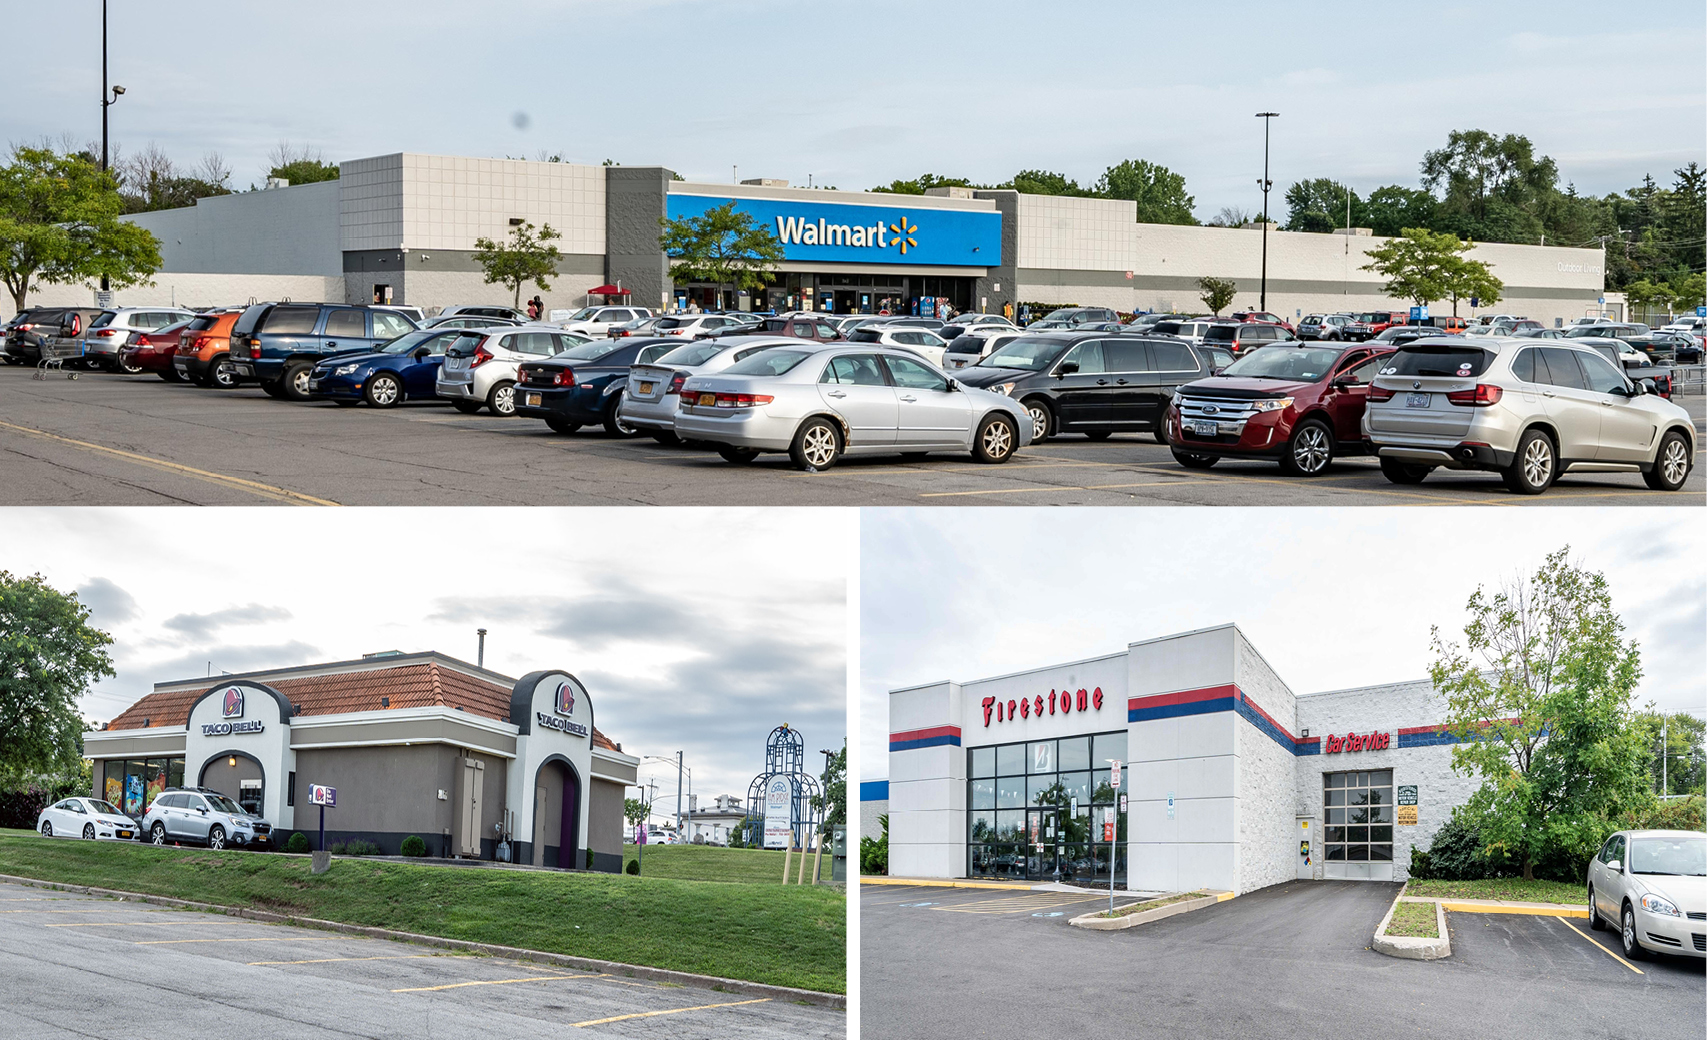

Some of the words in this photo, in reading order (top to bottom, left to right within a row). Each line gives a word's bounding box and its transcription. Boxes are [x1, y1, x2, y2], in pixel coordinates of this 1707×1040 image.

[776, 215, 887, 248] Walmart
[1557, 262, 1583, 272] Outdoor
[1583, 262, 1601, 275] Living
[981, 686, 1104, 728] Firestone
[201, 722, 231, 735] TACO
[232, 720, 263, 733] BELL
[541, 713, 565, 731] TACO
[566, 720, 589, 737] BELL
[1325, 734, 1346, 753] Car
[1345, 730, 1390, 752] Service
